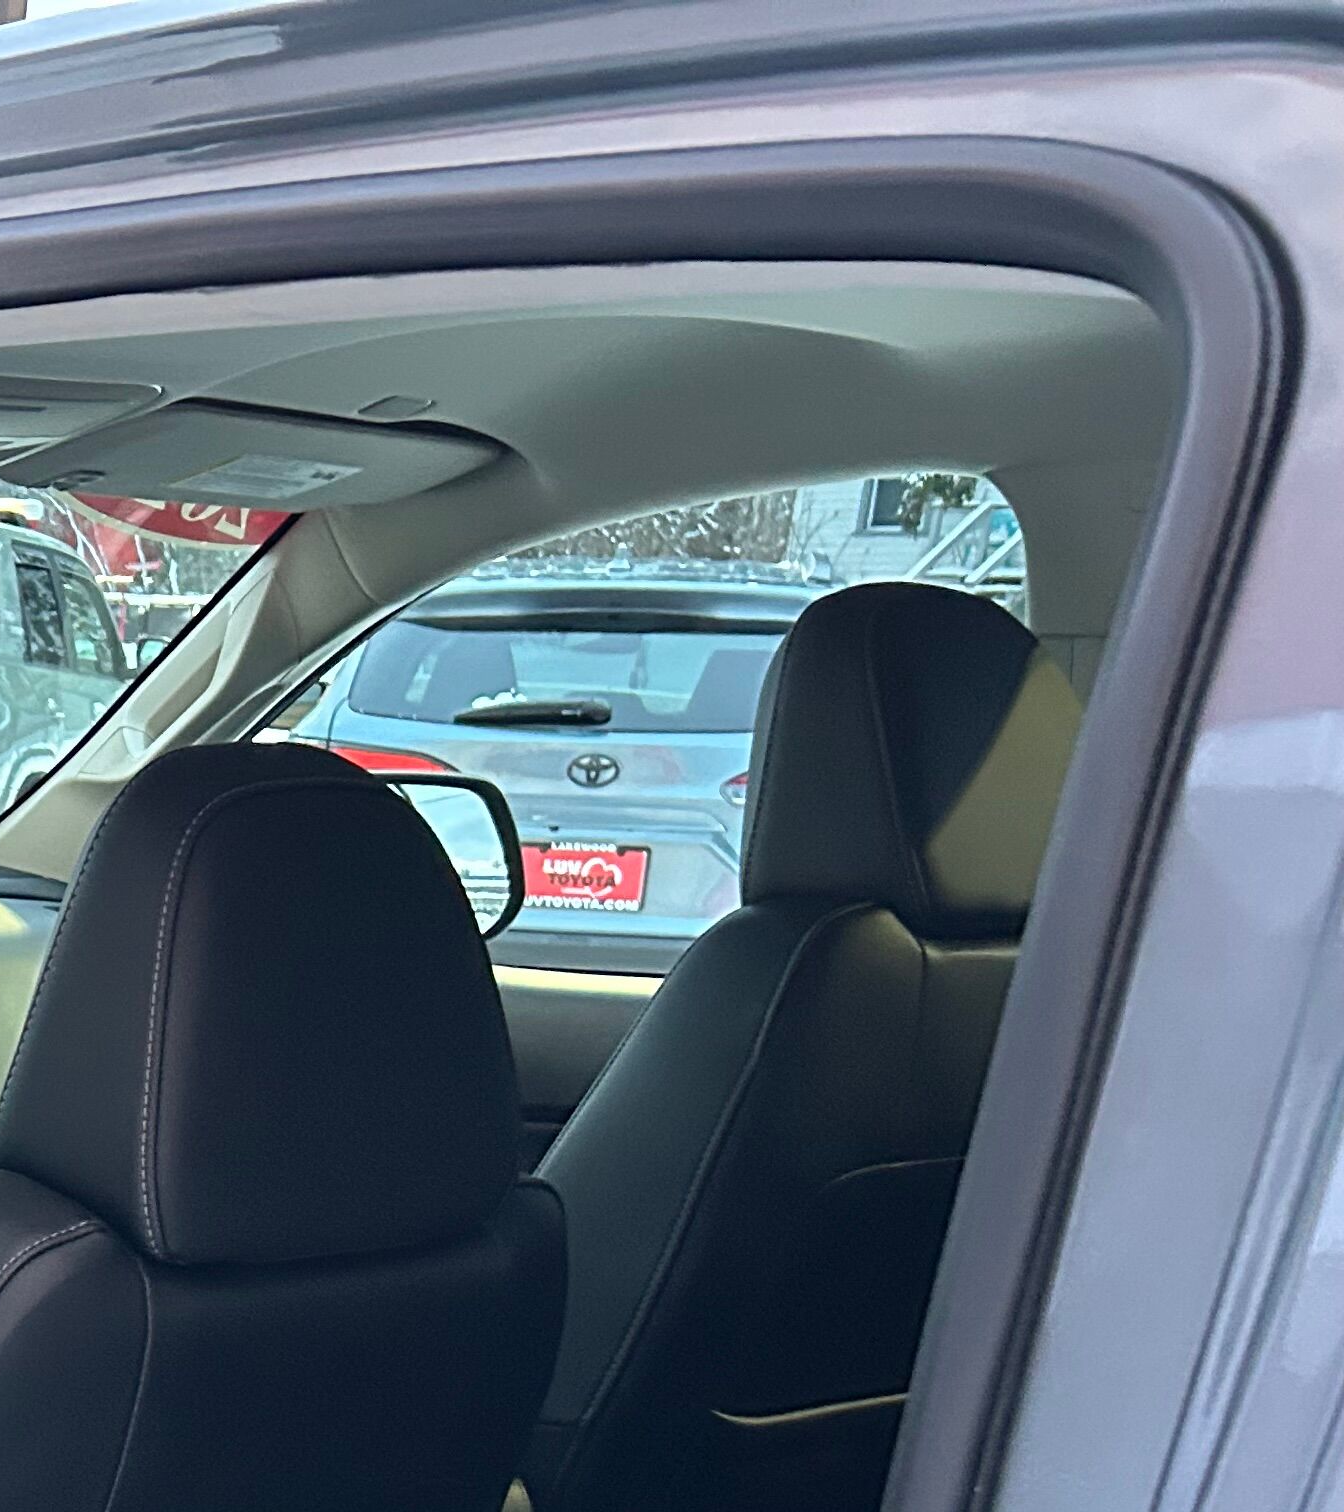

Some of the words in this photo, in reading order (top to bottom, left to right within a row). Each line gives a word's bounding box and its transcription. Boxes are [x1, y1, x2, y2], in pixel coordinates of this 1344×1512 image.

[542, 858, 582, 875] LUV
[547, 873, 617, 888] TOYOTA
[523, 895, 640, 912] UVTOYOTA.COM
